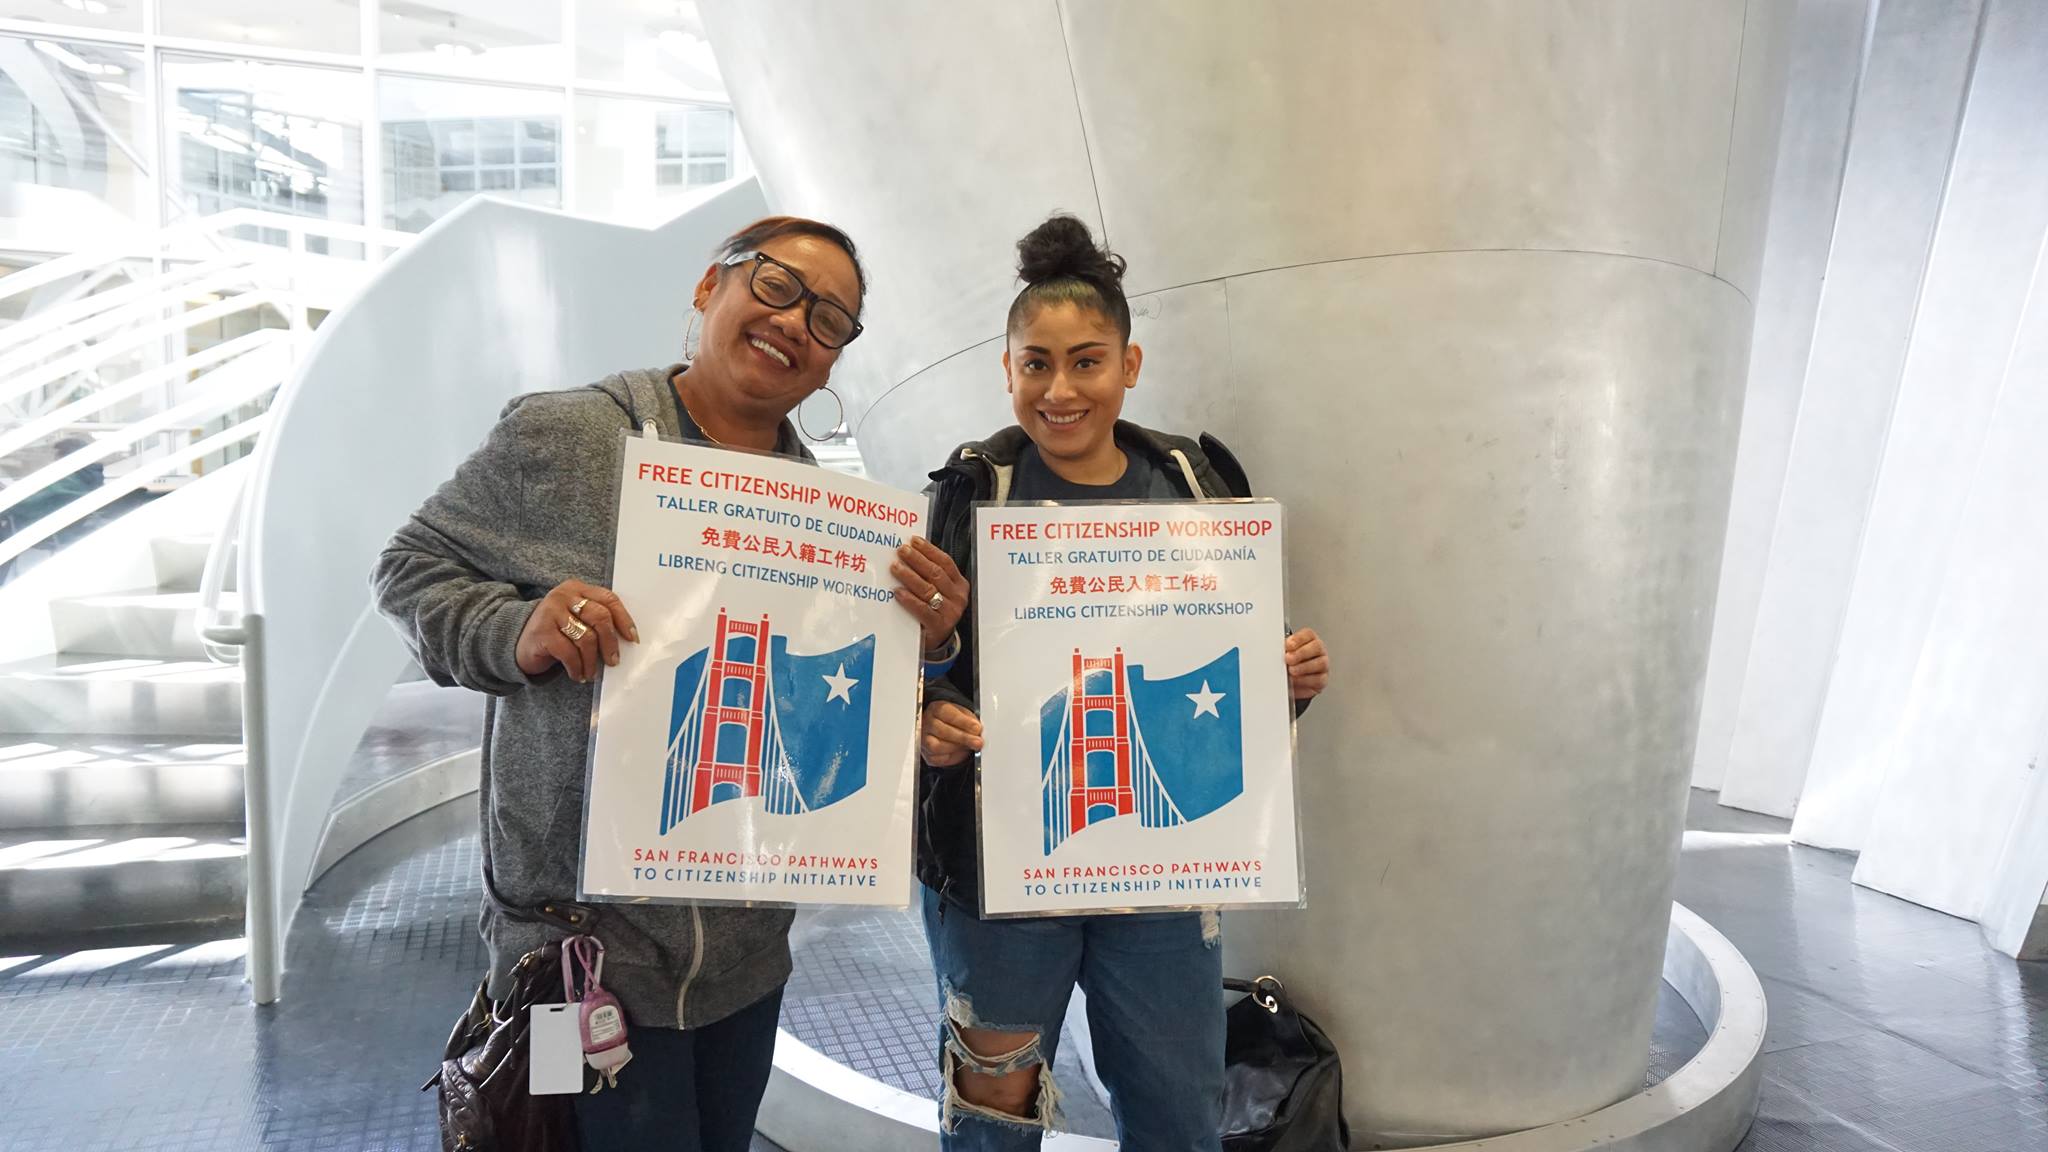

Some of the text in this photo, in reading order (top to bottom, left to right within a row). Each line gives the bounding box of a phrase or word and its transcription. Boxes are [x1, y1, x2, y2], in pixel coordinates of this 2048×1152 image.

[638, 463, 919, 527] FREE CITIZENSHIP WORKSHOP
[656, 494, 903, 549] TALLER GRATUITO DE CIUDADANÍA
[990, 519, 1273, 541] FREE CITIZENSHIP WORKSHOP
[701, 527, 867, 573] 免費公民入籍工作坊
[1008, 545, 1257, 565] TALLER GRATUITO DE CIUDADANÍA
[658, 553, 895, 604] LIBRENG CITIZENSHIP WORKSHOP
[1050, 574, 1218, 595] 免費公民入籍工作坊
[1014, 601, 1254, 620] LIBRENG CITIZENSHIP WORKSHOP
[634, 848, 879, 870] SAN FRANCISCO PATHWAYS
[633, 867, 877, 887] TO CITIZENSHIP INITIATIVE
[1023, 860, 1262, 880] SAN FRANCISCO PATHWAYS
[1024, 876, 1262, 896] TO CITIZENSHIP INITIATIVE
